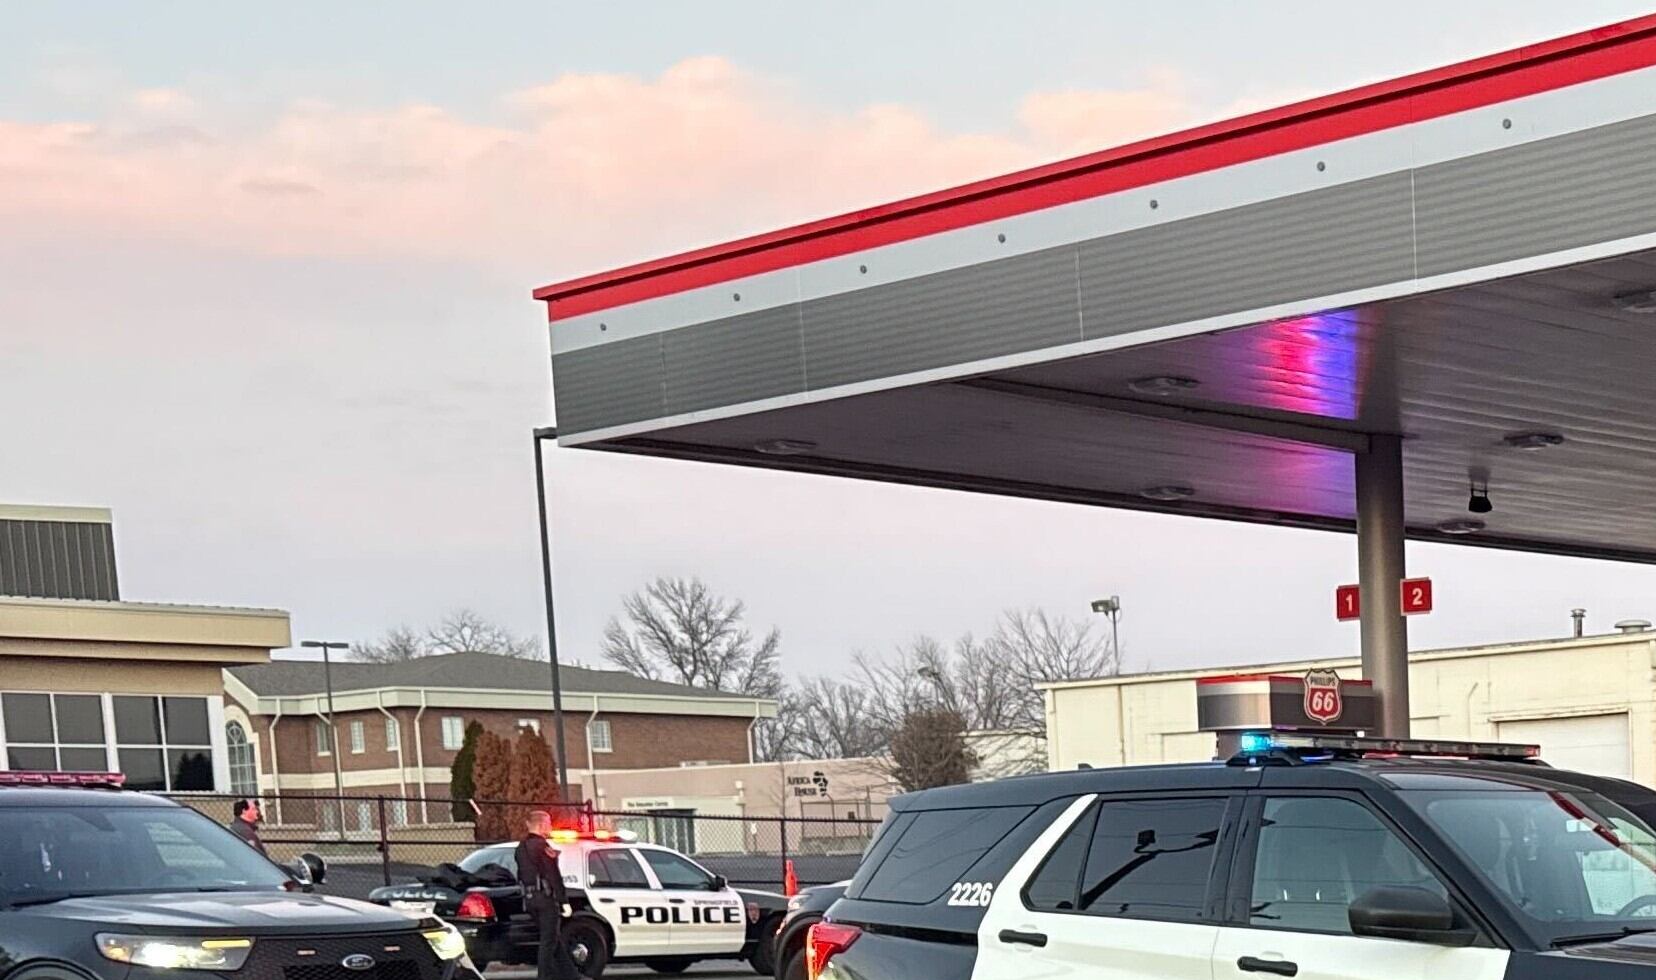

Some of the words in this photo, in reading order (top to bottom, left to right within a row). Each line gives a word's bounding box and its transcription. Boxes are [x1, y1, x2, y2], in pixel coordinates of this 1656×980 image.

[1345, 594, 1353, 612] 1
[1412, 588, 1423, 606] 2
[1312, 691, 1335, 712] 66
[381, 889, 448, 900] OLICE
[947, 882, 993, 907] 2226
[620, 906, 742, 924] POLICE
